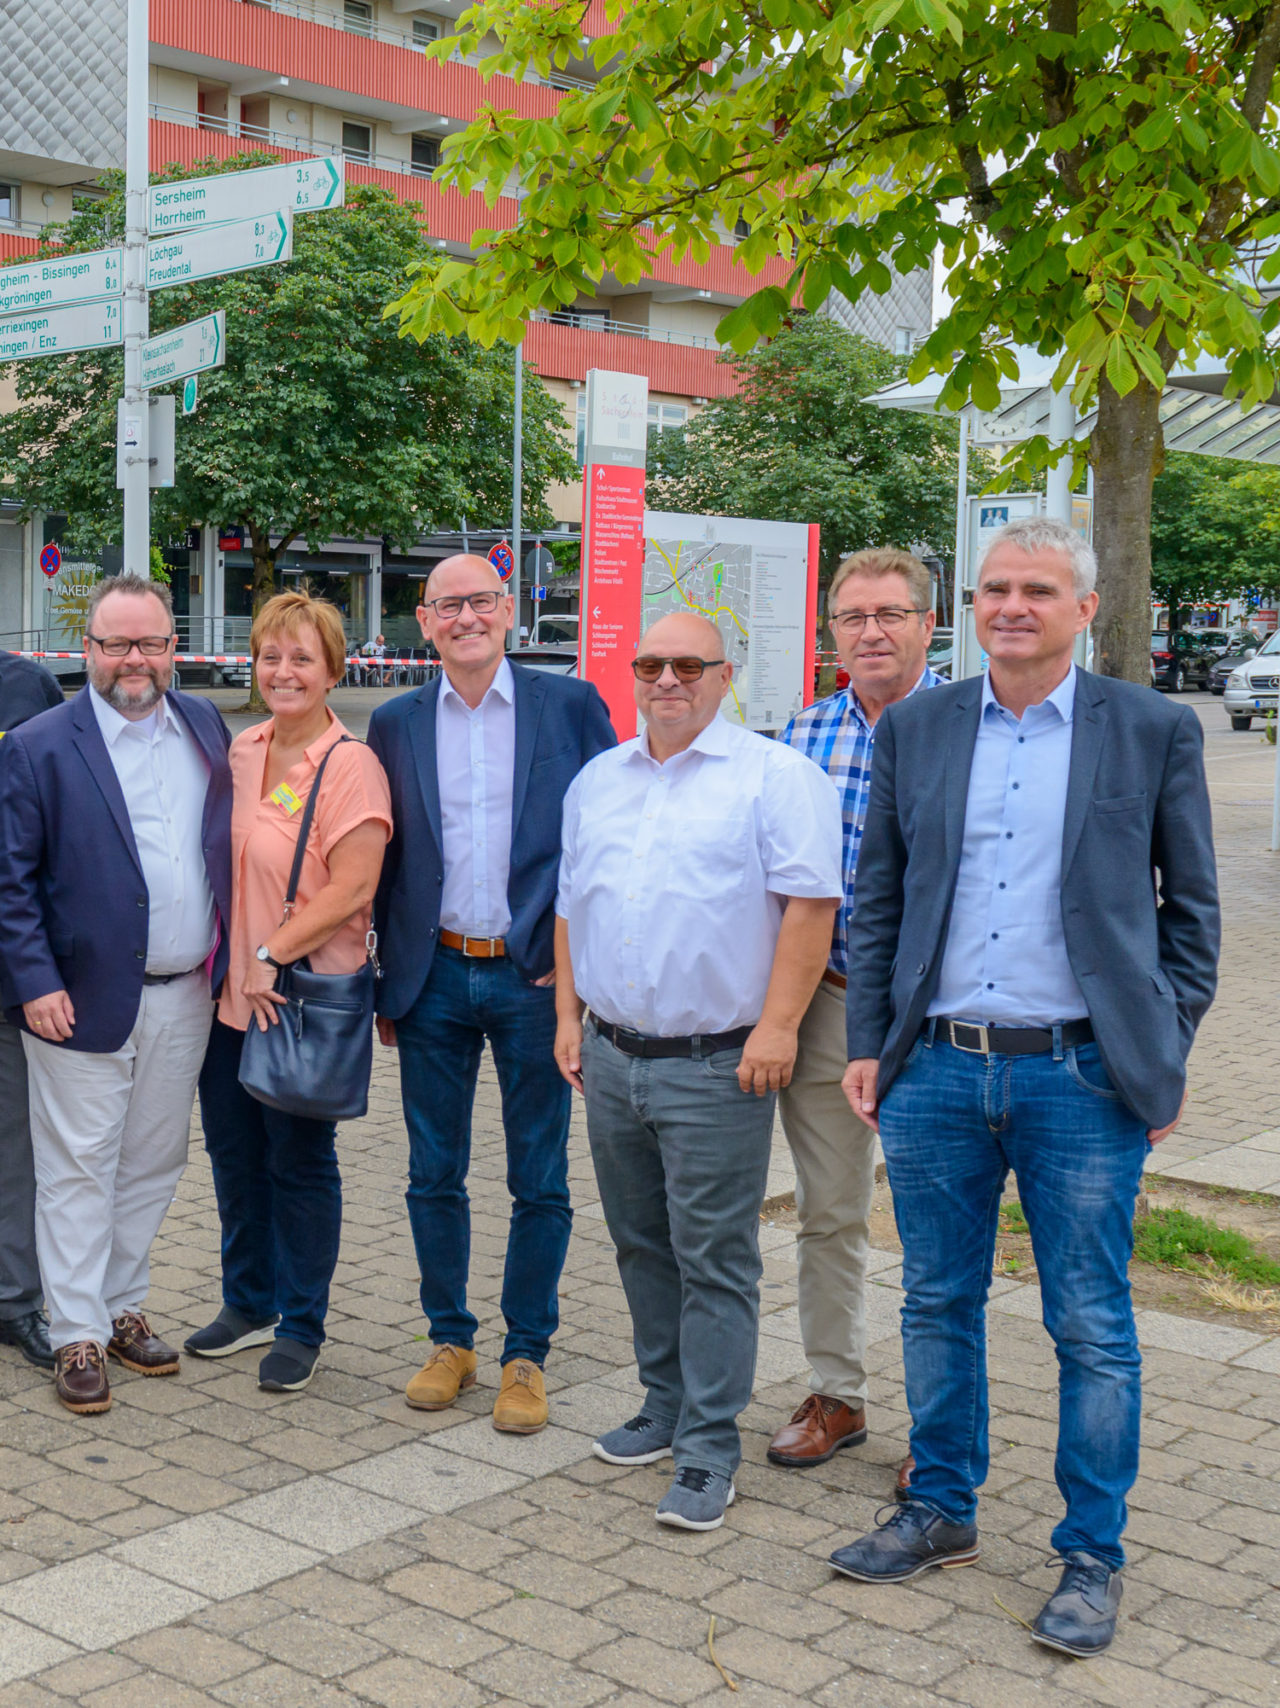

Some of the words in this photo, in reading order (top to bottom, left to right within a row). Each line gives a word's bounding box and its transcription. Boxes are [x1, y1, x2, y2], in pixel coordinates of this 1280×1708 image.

[155, 187, 206, 206] Sersheim
[297, 169, 309, 183] 3,5
[155, 208, 206, 226] Horrheim
[296, 191, 309, 205] 6,5
[149, 244, 183, 262] Löchgau
[42, 263, 90, 281] Bissingen
[149, 260, 191, 282] Freudental
[39, 335, 57, 348] Enz
[103, 325, 112, 339] 11
